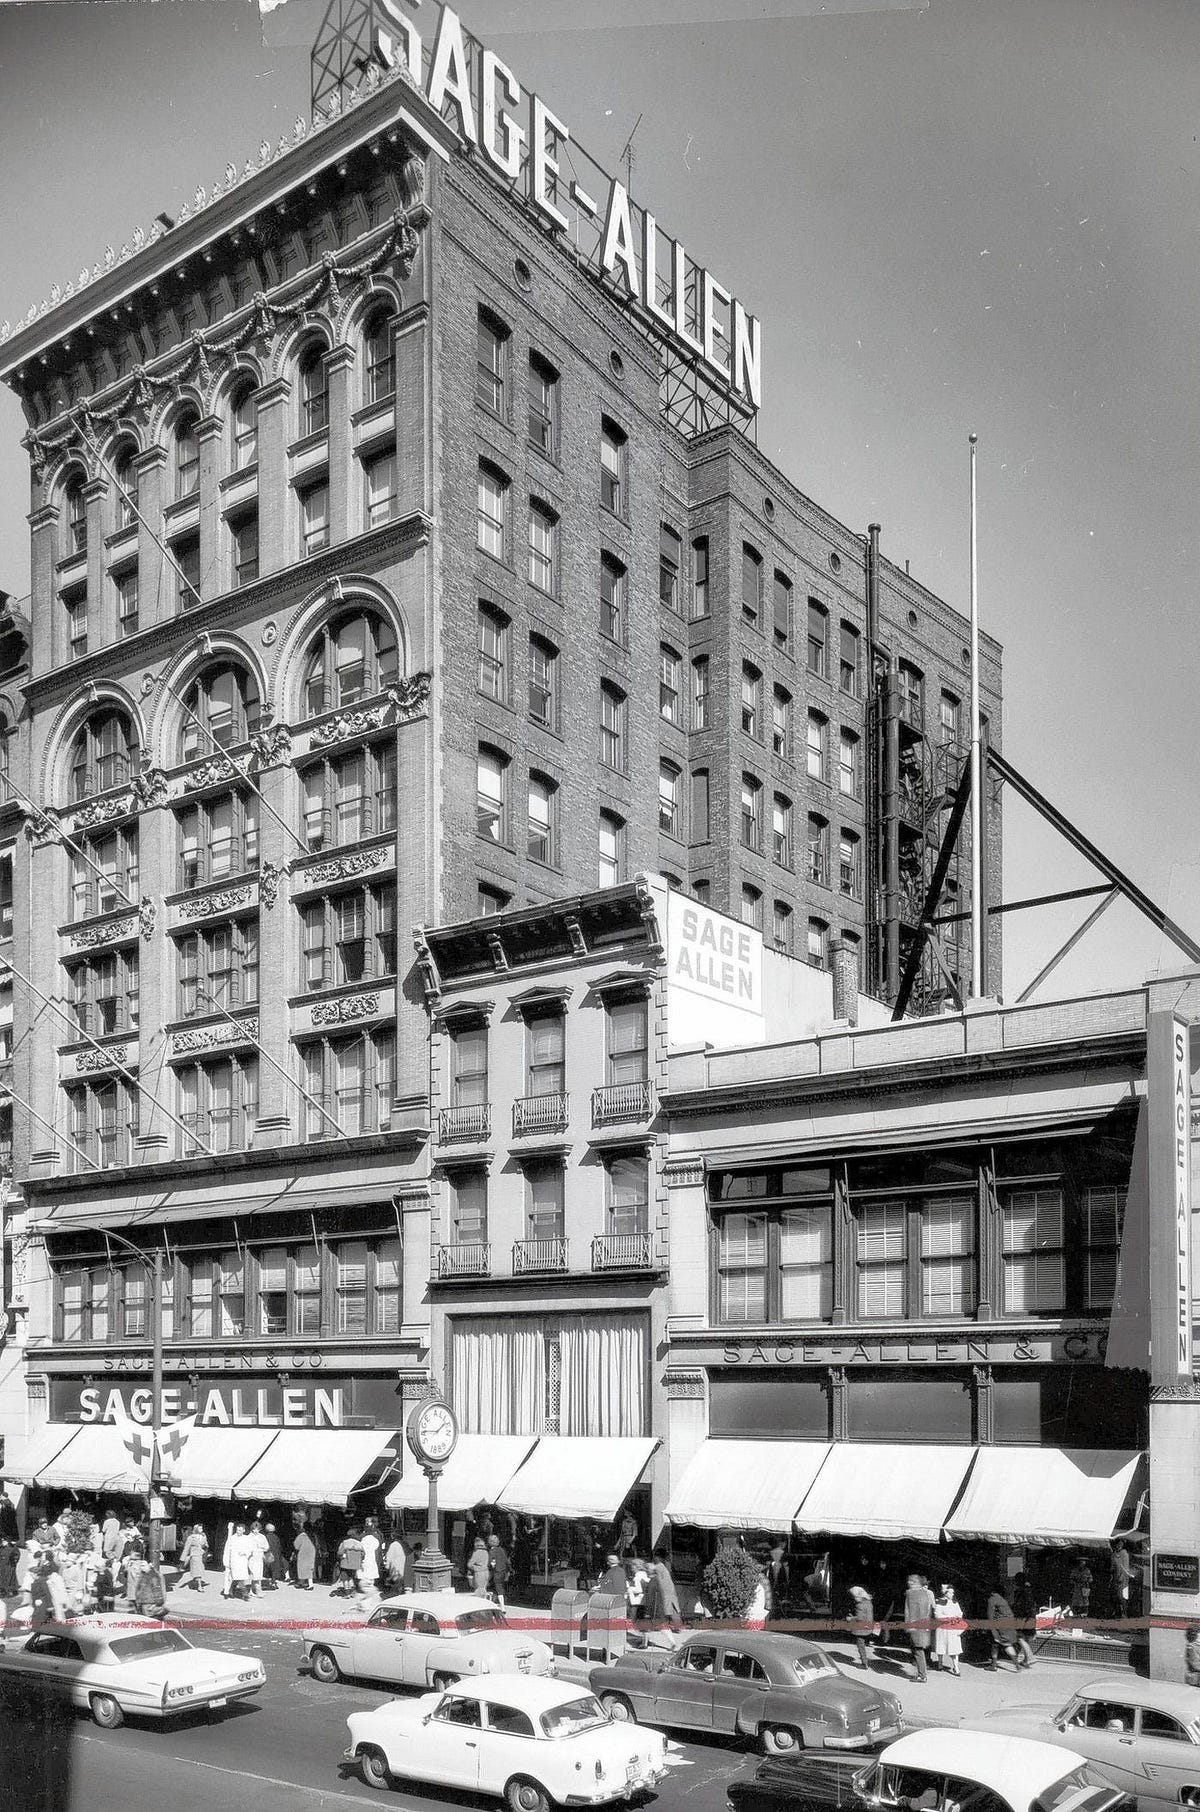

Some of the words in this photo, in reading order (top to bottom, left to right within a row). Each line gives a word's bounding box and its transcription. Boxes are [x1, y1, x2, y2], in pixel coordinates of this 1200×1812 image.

[683, 909, 751, 964] SAGE
[676, 946, 753, 1000] ALLEN
[265, 1350, 279, 1368] &
[1013, 1336, 1040, 1361] &
[79, 1387, 343, 1427] SAGE-ALLEN
